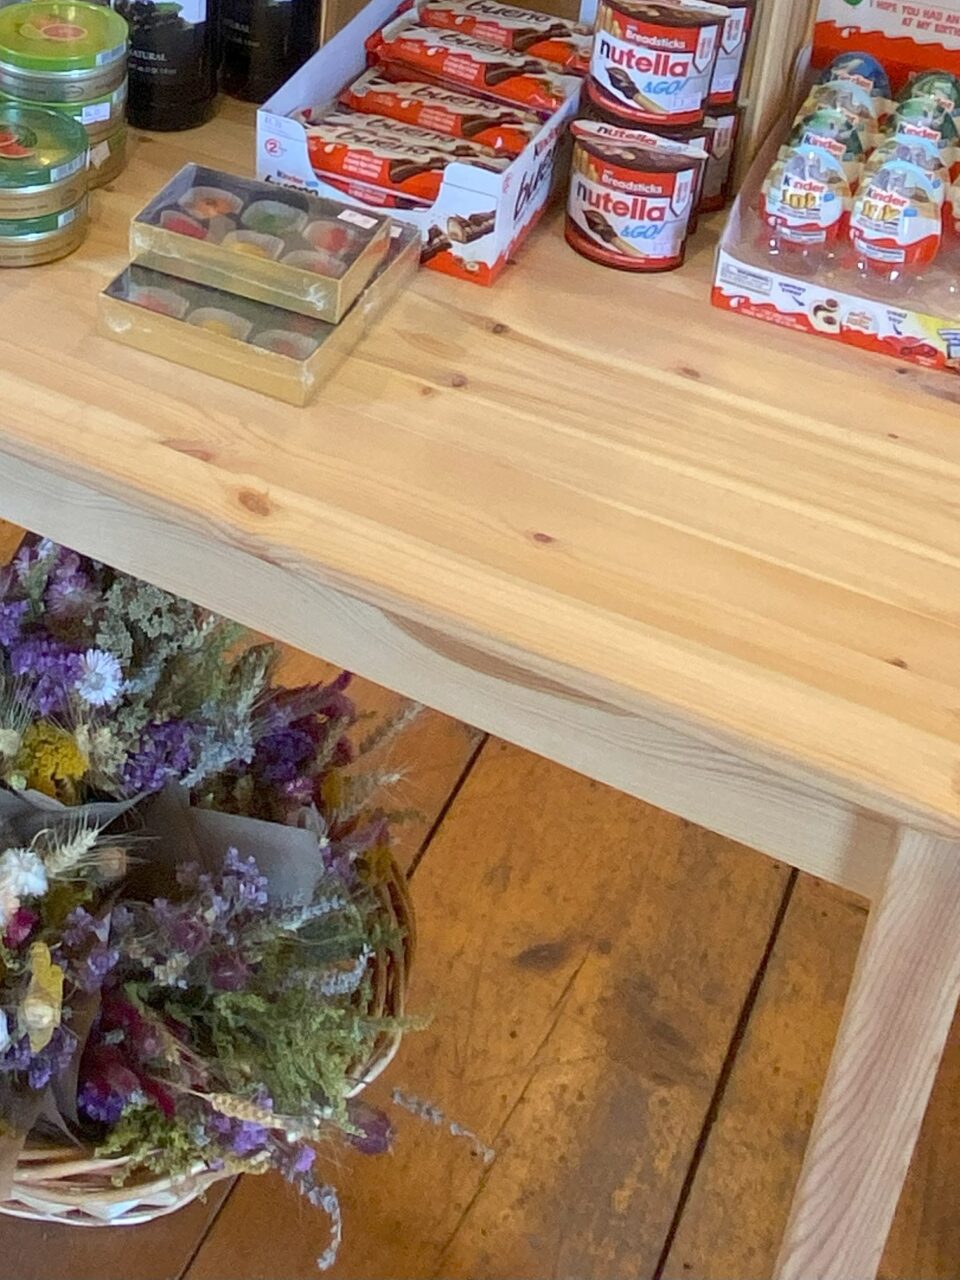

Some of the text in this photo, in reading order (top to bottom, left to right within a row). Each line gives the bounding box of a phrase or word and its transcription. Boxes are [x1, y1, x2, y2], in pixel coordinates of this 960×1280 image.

[466, 0, 551, 22] bueno
[902, 5, 920, 17] YOU
[625, 30, 686, 50] Breadsticks
[600, 38, 690, 78] nutella
[596, 126, 658, 147] nutella
[601, 176, 662, 194] Breadsticks
[783, 174, 825, 193] Knder
[577, 180, 667, 222] nutella
